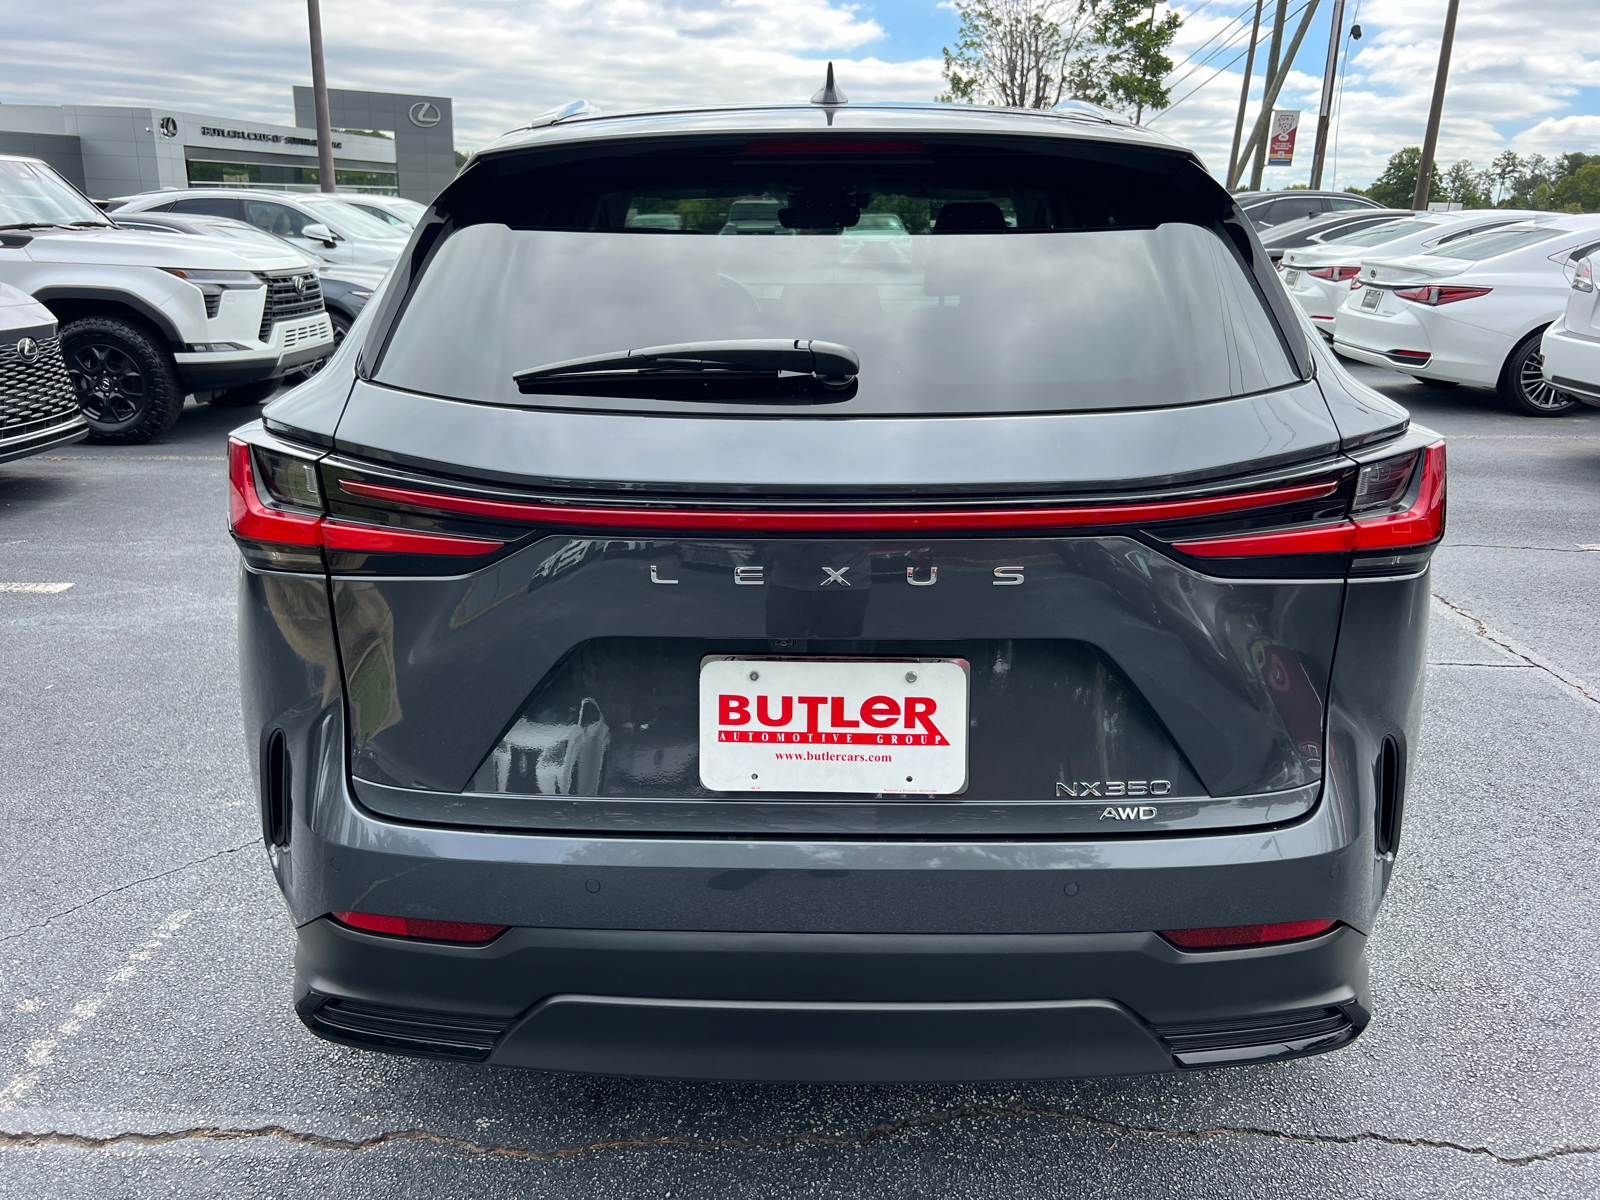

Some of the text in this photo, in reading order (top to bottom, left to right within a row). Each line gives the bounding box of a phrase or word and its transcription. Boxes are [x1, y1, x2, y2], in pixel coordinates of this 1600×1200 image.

[650, 565, 1025, 586] LEXUS
[719, 732, 942, 744] AUTOMOTIVE GROUP
[775, 751, 892, 763] www.butlercars.com
[1055, 780, 1171, 797] NX350
[1099, 806, 1158, 820] AWD
